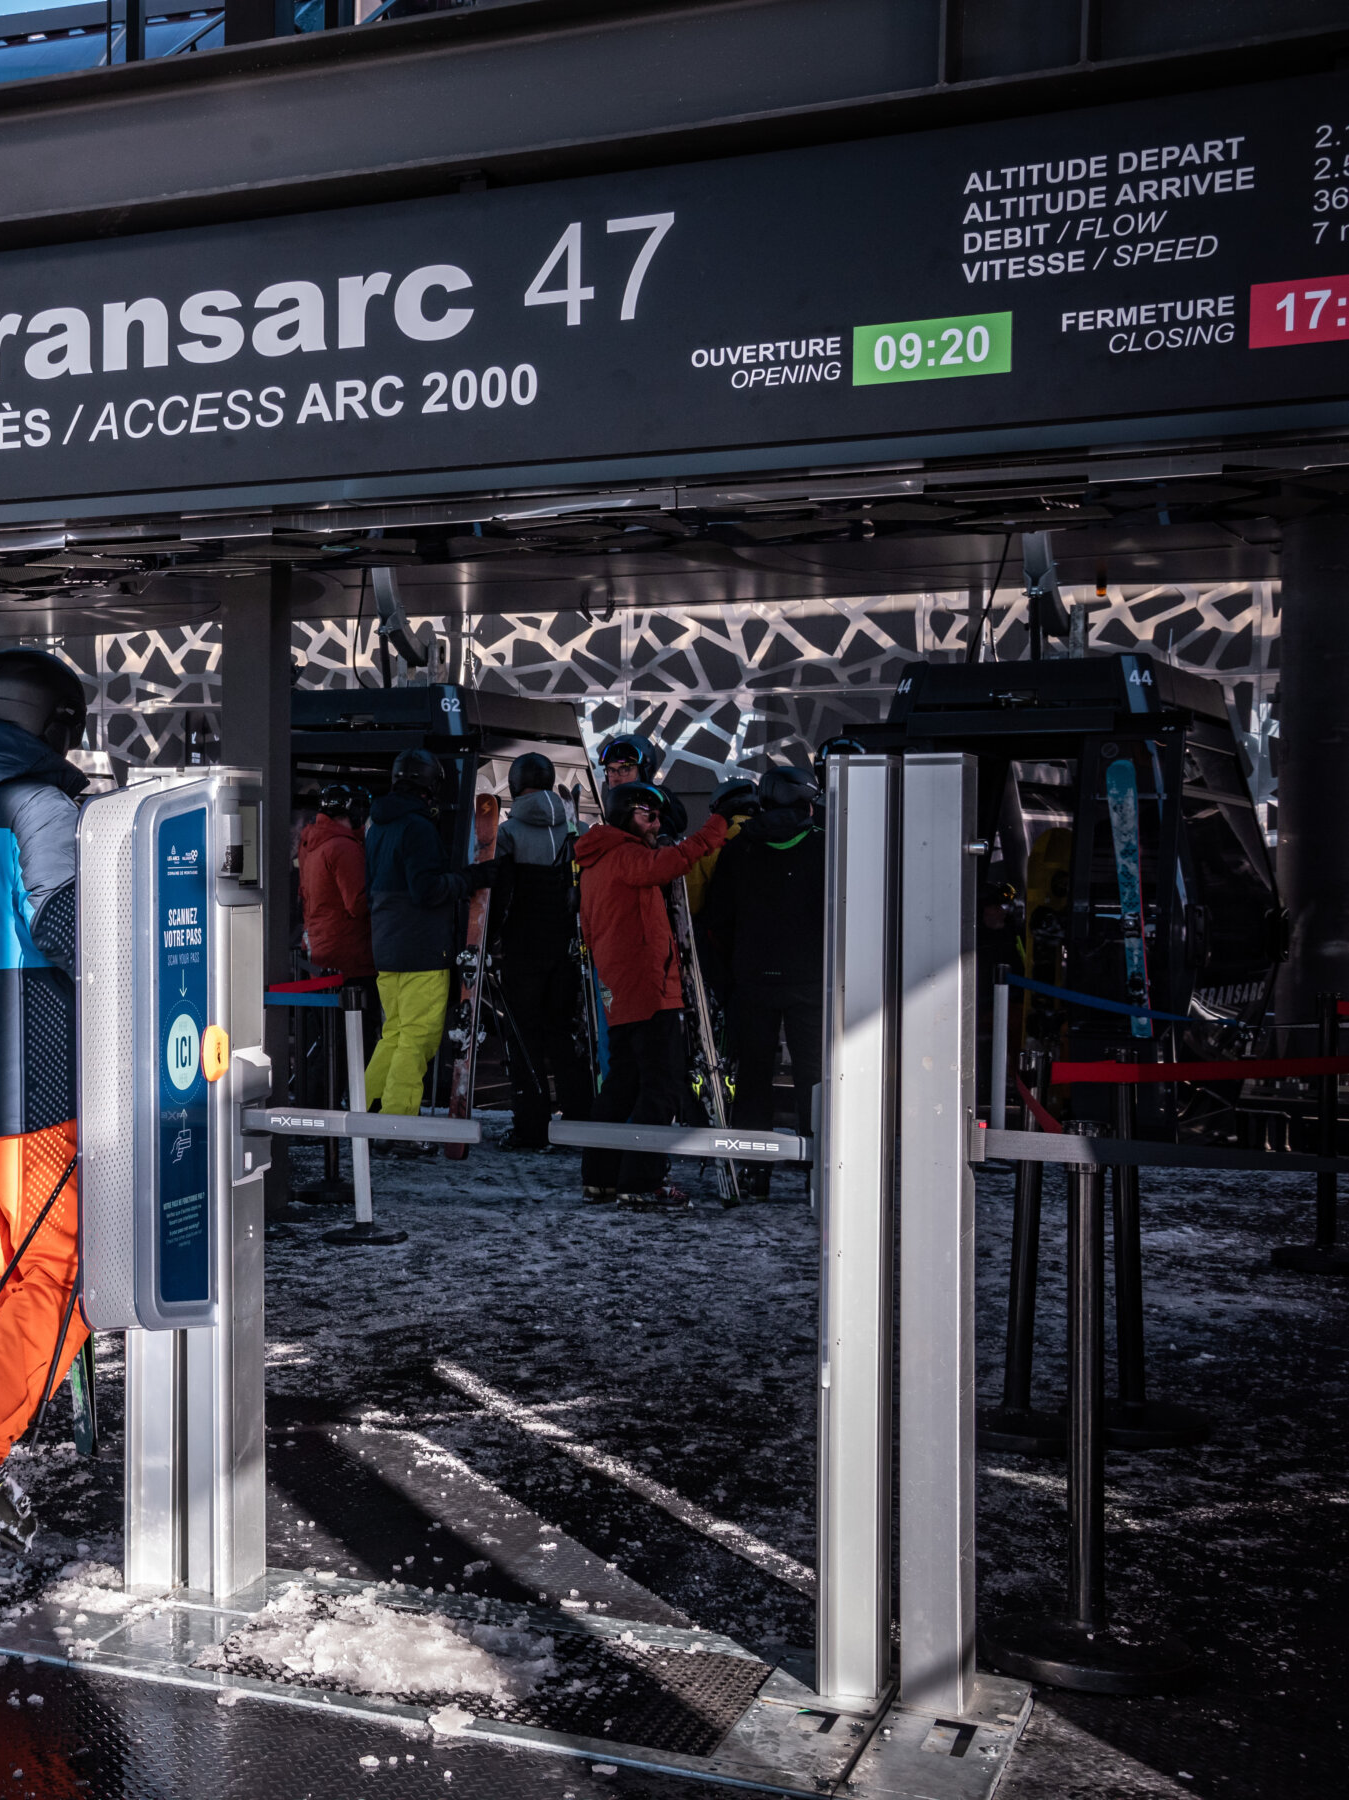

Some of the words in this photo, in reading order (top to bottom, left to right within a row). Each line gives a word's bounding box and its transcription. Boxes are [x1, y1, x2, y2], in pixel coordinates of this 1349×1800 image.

[963, 155, 1107, 195] ALTITUDE
[1118, 136, 1245, 174] DEPART
[962, 186, 1107, 225] ALTITUDE
[1114, 166, 1255, 206] ARRIVEE
[963, 223, 1051, 255] DEBIT
[1056, 220, 1071, 244] /
[1075, 210, 1168, 241] FLOW
[524, 211, 675, 327] 47
[961, 249, 1085, 284] VITESSE
[1092, 247, 1108, 271] /
[1113, 235, 1219, 267] SPEED
[1061, 295, 1235, 333] FERMETURE
[1276, 289, 1347, 332] 17:
[692, 336, 841, 368] OUVERTURE
[874, 325, 990, 372] 09:20
[1108, 322, 1235, 354] CLOSING
[730, 361, 842, 389] OPENING
[61, 403, 85, 446] /
[88, 385, 286, 442] ACCESS
[296, 375, 405, 425] ARC
[421, 363, 538, 414] 2000
[897, 678, 912, 695] 44
[1129, 670, 1152, 686] 44
[440, 697, 461, 712] 62
[168, 907, 198, 926] SCANNEZ
[163, 929, 185, 948] VOTRE
[186, 928, 202, 946] PASS
[167, 954, 178, 966] SCAN
[179, 952, 190, 964] YOUR
[190, 951, 200, 963] PASS
[1199, 981, 1266, 1008] TRANSARC
[175, 1035, 191, 1068] ICI
[270, 1116, 325, 1127] AXESS
[714, 1138, 779, 1152] AXESS
